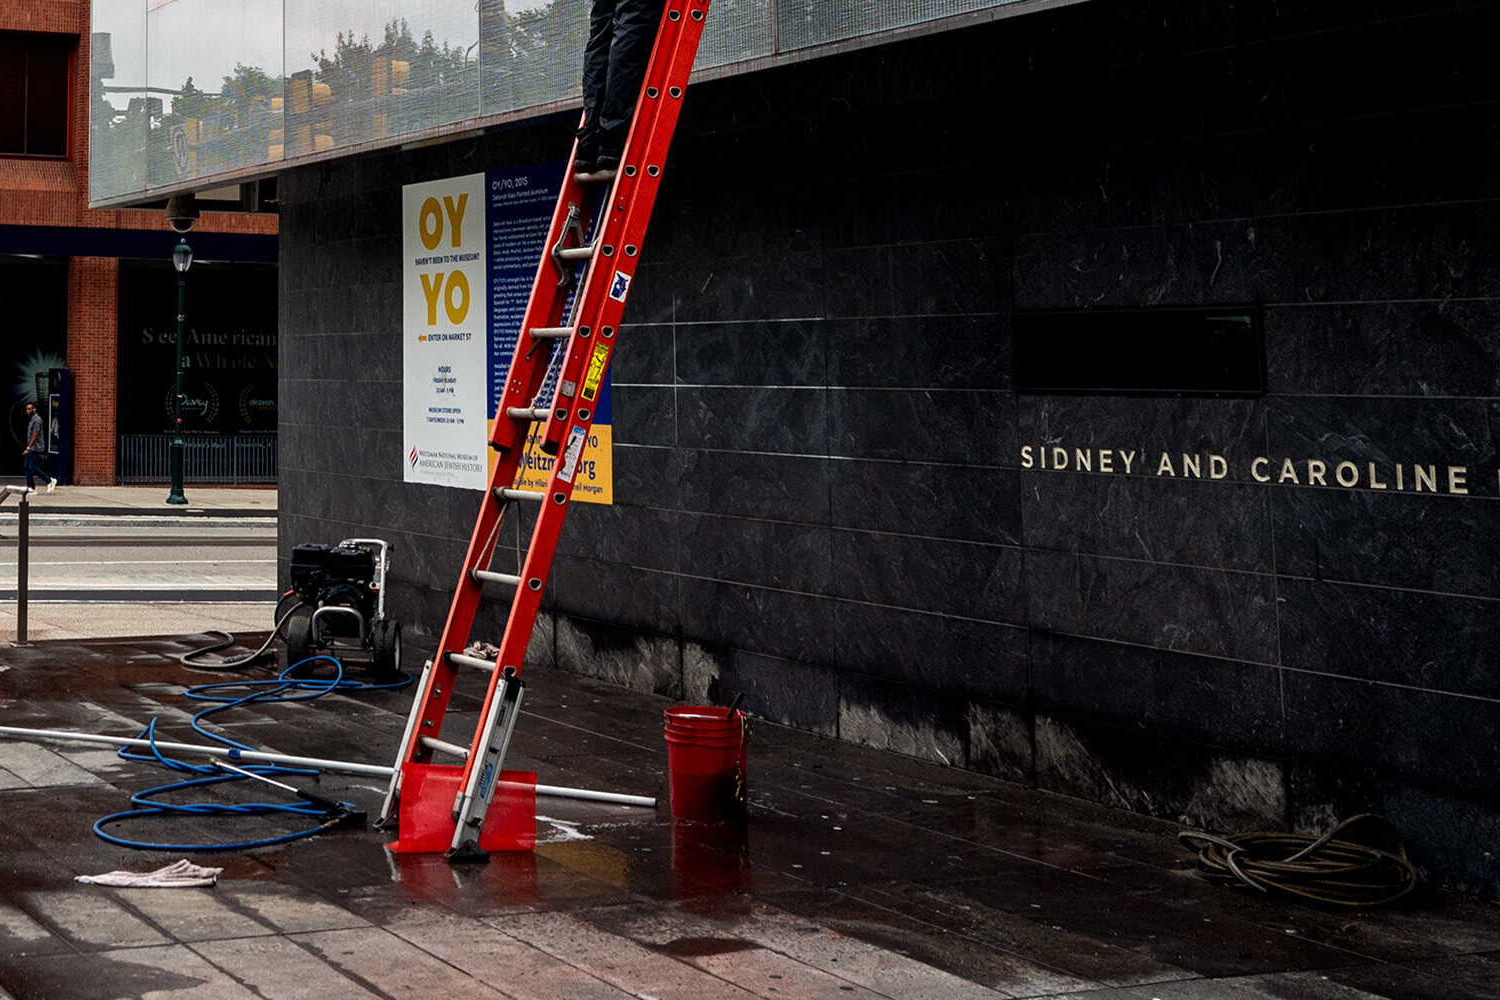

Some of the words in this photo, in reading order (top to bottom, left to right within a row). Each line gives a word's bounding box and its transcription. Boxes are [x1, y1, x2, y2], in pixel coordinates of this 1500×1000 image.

[418, 193, 470, 250] OY
[459, 252, 480, 262] MUSEUM?
[419, 270, 470, 326] YO
[142, 327, 178, 344] See
[187, 328, 276, 346] American
[181, 355, 191, 368] a
[444, 461, 461, 471] JEWISH
[462, 463, 484, 472] HISTORY
[1020, 446, 1136, 474] SIDNEY
[1156, 452, 1228, 479] AND
[1251, 456, 1469, 494] CAROLINE
